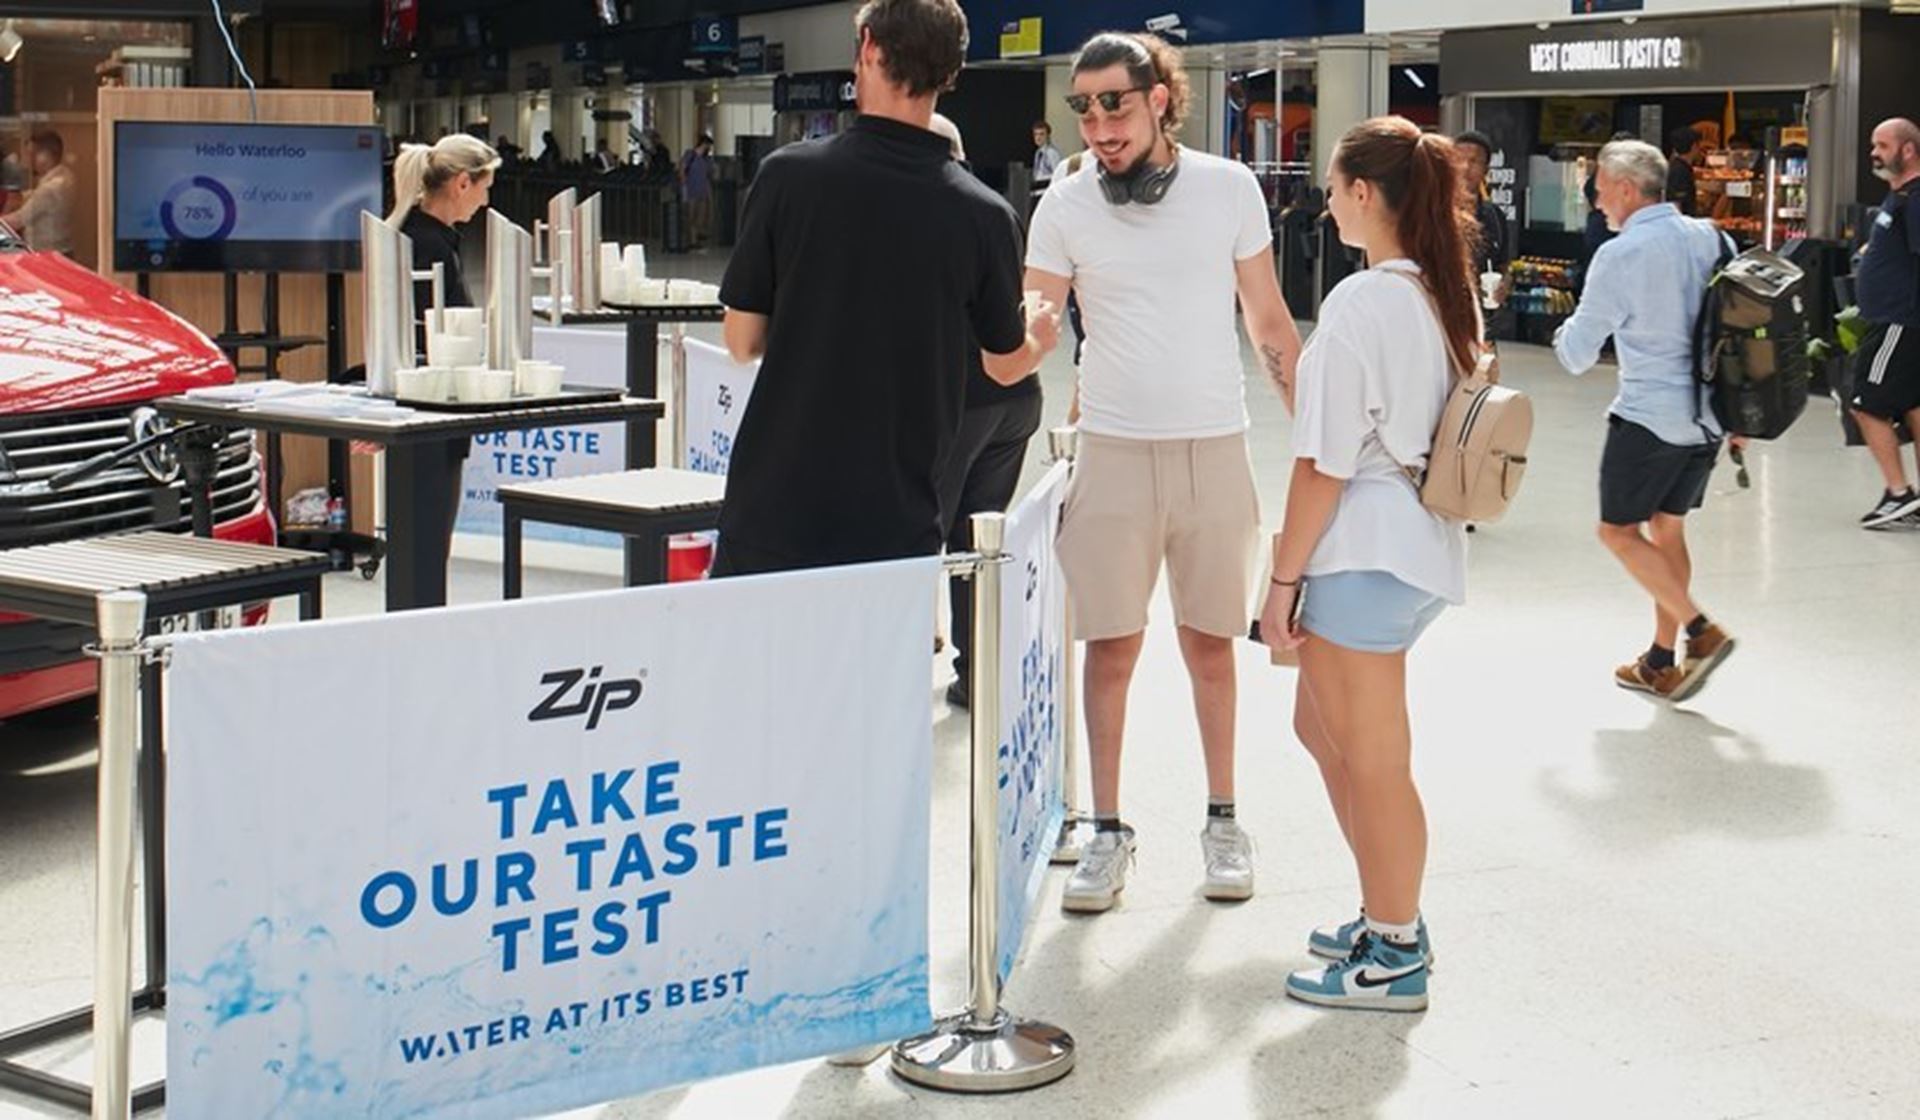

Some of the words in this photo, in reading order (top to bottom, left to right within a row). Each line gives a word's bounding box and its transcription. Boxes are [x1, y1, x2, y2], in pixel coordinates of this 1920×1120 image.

[707, 22, 721, 41] 6
[1530, 43, 1559, 71] WEST
[1560, 40, 1621, 71] CORNWALL
[1623, 38, 1661, 69] PASTY
[196, 142, 234, 157] Hello
[238, 143, 306, 158] Waterloo
[242, 187, 259, 201] of
[260, 190, 288, 203] you
[289, 190, 314, 202] are
[184, 207, 214, 219] 78%
[516, 427, 599, 455] TASTE
[493, 452, 557, 477] TEST
[528, 666, 641, 730] Zip
[488, 762, 681, 839] TAKE
[360, 852, 535, 928] OUR
[567, 808, 787, 891] TASTE
[492, 892, 670, 972] TEST
[400, 1017, 530, 1063] WATER
[544, 1002, 588, 1034] AT
[601, 990, 651, 1023] ITS
[666, 970, 749, 1008] BEST
